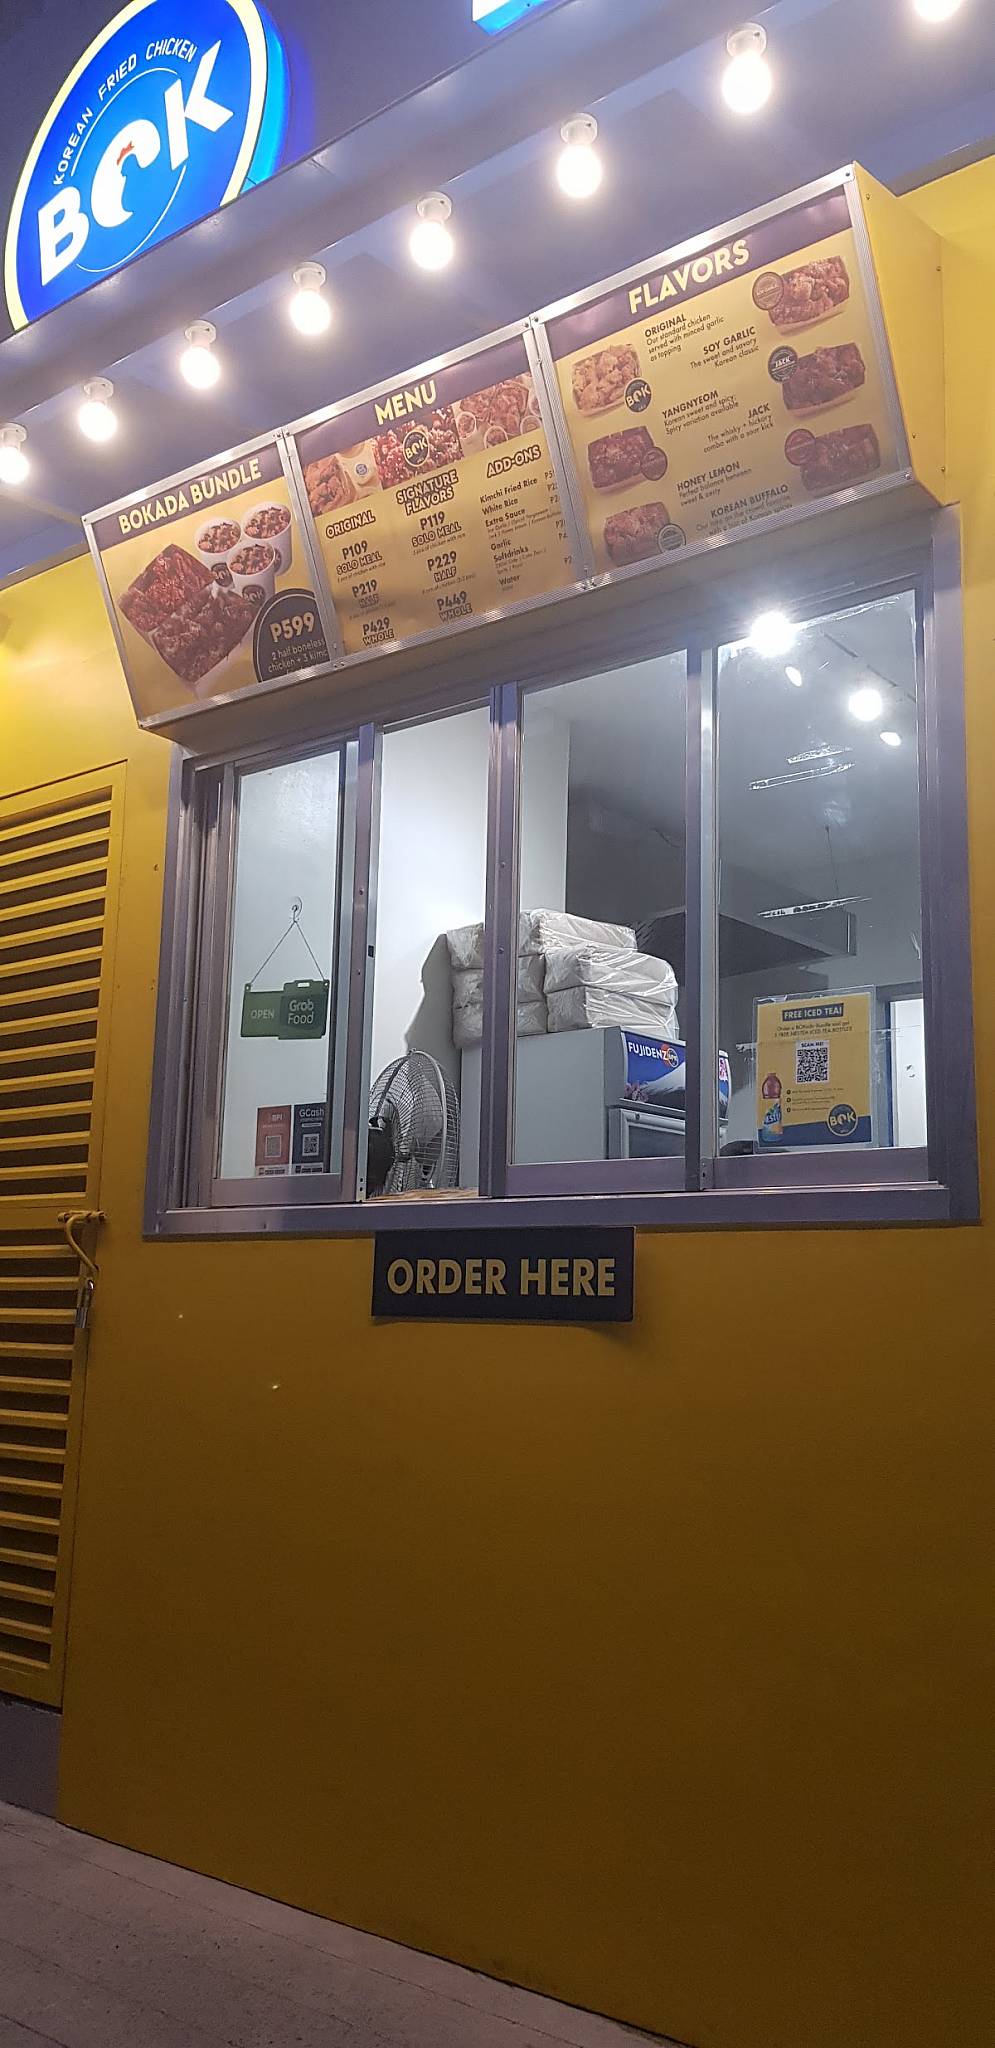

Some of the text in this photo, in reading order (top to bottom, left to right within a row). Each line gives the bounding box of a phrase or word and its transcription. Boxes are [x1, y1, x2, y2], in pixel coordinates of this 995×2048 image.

[53, 37, 197, 185] KOREAN FRIED CHICKEN
[37, 40, 234, 286] BOK
[628, 239, 750, 314] FLAVORS
[644, 313, 687, 338] ORIGINAL
[646, 313, 711, 347] Our standard chicken
[648, 316, 724, 353] served with minced garlic
[703, 326, 756, 355] SOY GARLIC
[658, 344, 682, 361] topping
[690, 338, 757, 370] The sweet and savory
[715, 347, 759, 368] Korean classic
[775, 356, 791, 367] JACK
[375, 379, 436, 425] MENU
[626, 386, 650, 406] BOK
[662, 390, 718, 418] YANGNYEOM
[664, 414, 685, 427] Korean
[686, 408, 703, 420] sweet
[705, 401, 717, 411] and
[665, 402, 739, 435] Spicy variation available
[748, 403, 770, 418] JACK
[405, 437, 428, 459] BOK
[703, 442, 725, 453] combo
[726, 436, 739, 445] with
[708, 434, 719, 443] The
[487, 445, 541, 478] ADD-ONS
[396, 469, 458, 504] SIGNATURE
[480, 469, 555, 503] Kimchi Fried Rice P5
[677, 461, 740, 491] HONEY LEMON
[119, 458, 261, 534] BOKADA BUNDLE
[405, 487, 454, 516] FLAVORS
[711, 499, 747, 518] KOREAN
[749, 484, 788, 504] BUFFALO
[482, 504, 503, 516] White
[504, 498, 518, 508] Rice
[326, 509, 376, 538] ORIGINAL
[420, 511, 445, 530] P119
[485, 516, 503, 527] Extra
[505, 509, 525, 520] Sauce
[412, 521, 462, 547] SOLO MEAL
[490, 538, 511, 550] Garlic
[342, 540, 368, 560] P109
[493, 546, 529, 562] Softdrinks
[336, 550, 382, 575] SOLO MEAL
[427, 551, 457, 571] P229
[433, 566, 457, 582] HALF
[498, 575, 520, 585] Water
[352, 579, 377, 598] P219
[436, 590, 468, 611] P449
[439, 603, 473, 622] WHOLE
[270, 612, 315, 642] P599
[363, 617, 390, 635] P429
[362, 628, 395, 646] WHOLE
[272, 638, 326, 661] 2 half boneless
[268, 657, 295, 673] chicken
[251, 1009, 275, 1020] OPEN
[289, 999, 314, 1012] Grab
[784, 1010, 801, 1020] FREE
[804, 1008, 822, 1017] ICED
[287, 1012, 315, 1025] Food
[299, 1108, 325, 1117] GCash
[829, 1111, 856, 1127] BOK
[387, 1258, 616, 1296] ORDER HERE
